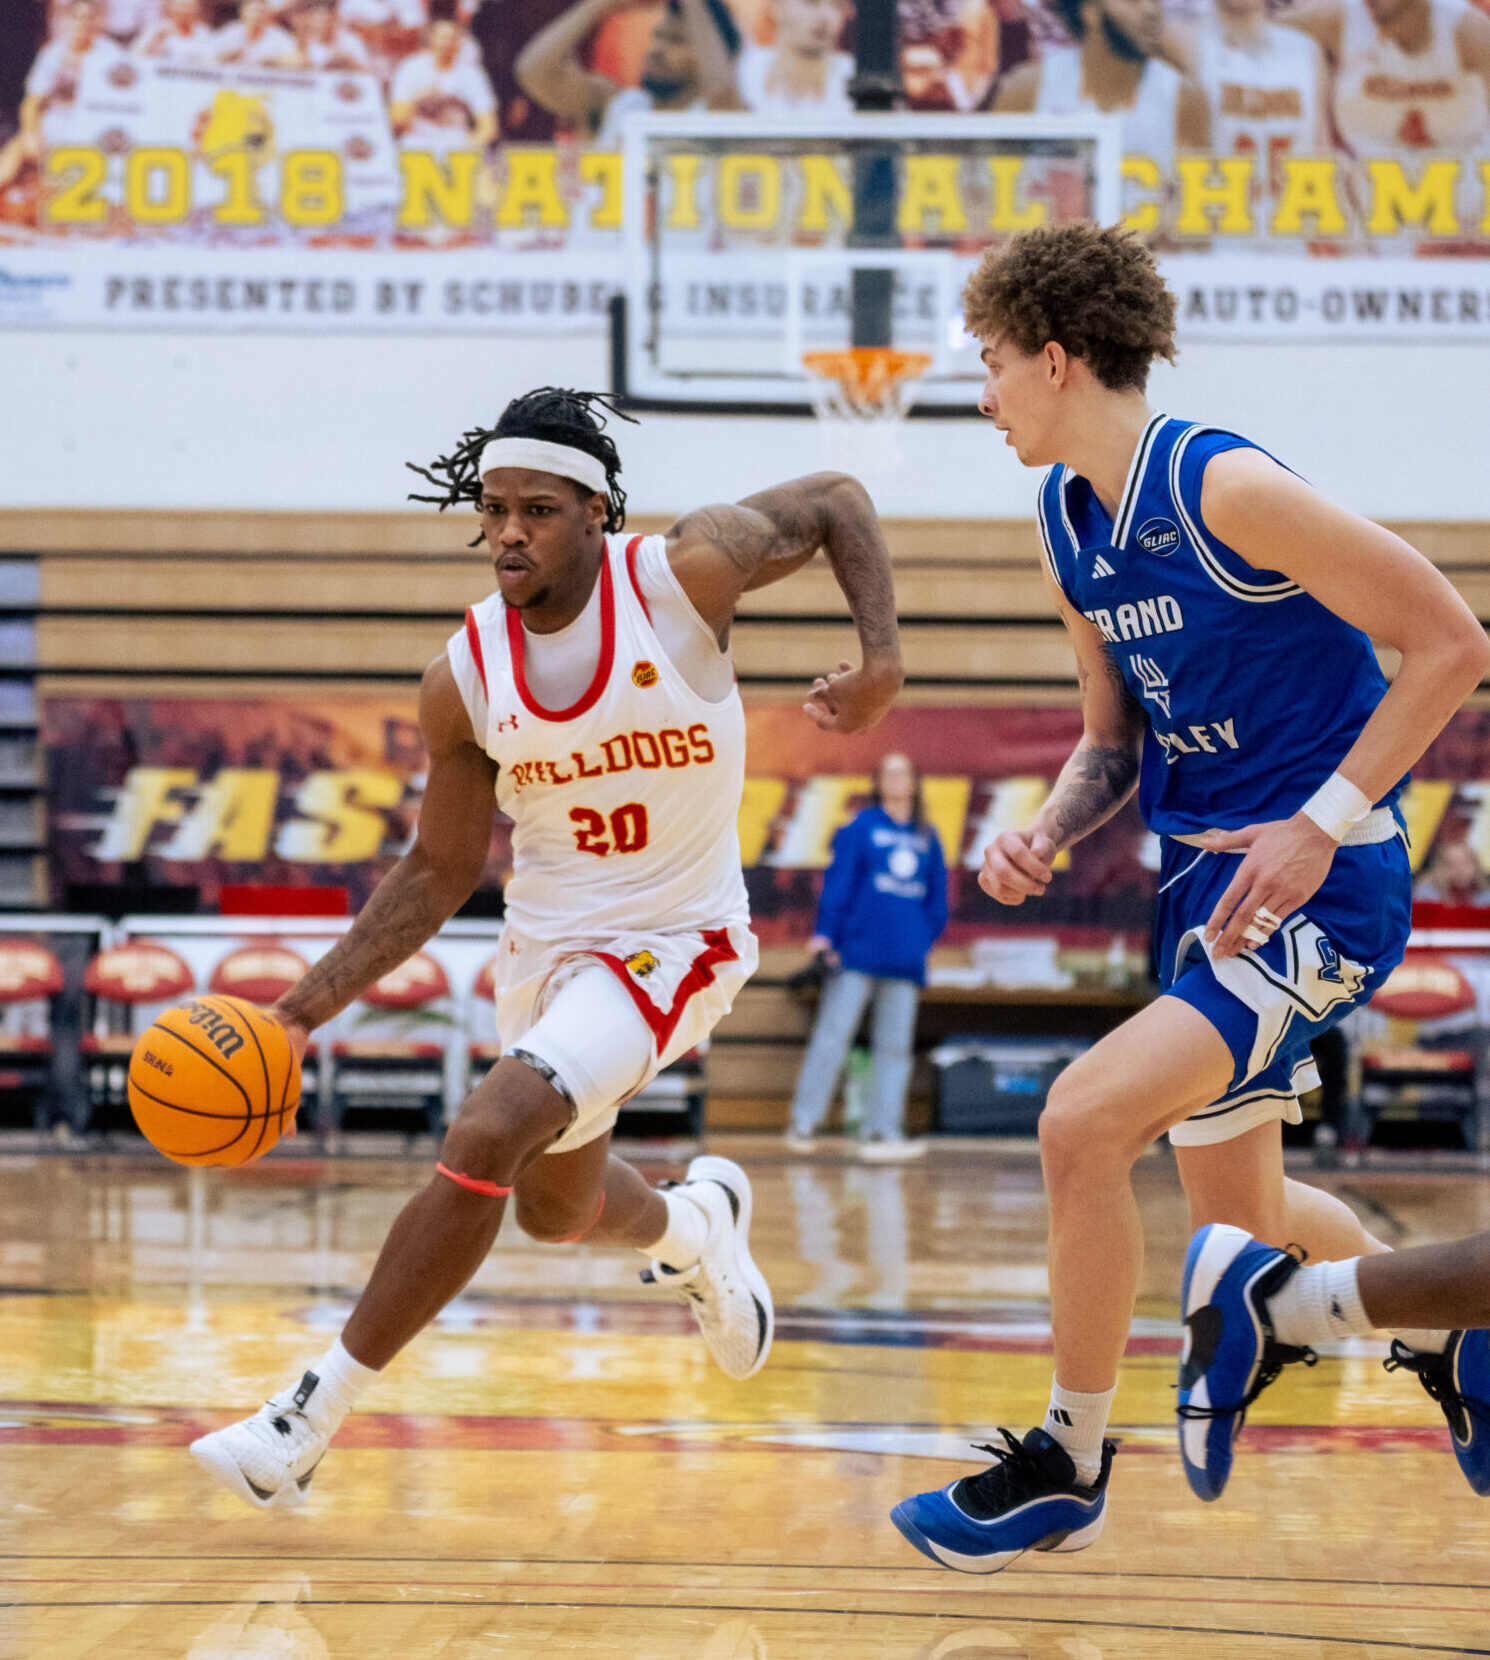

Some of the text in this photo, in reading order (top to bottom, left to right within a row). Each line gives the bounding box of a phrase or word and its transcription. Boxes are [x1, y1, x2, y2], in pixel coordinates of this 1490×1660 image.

[47, 146, 345, 225] 2018
[1118, 156, 1490, 236] CHAM
[104, 276, 356, 314] PRESENTED
[375, 279, 424, 314] BY
[443, 279, 664, 317] SCHUBE
[686, 281, 936, 320] INSURACE
[1186, 286, 1490, 324] AUTO-OWNER
[1143, 530, 1177, 548] GLIAC
[90, 767, 424, 863] FAS
[568, 802, 648, 857] 20
